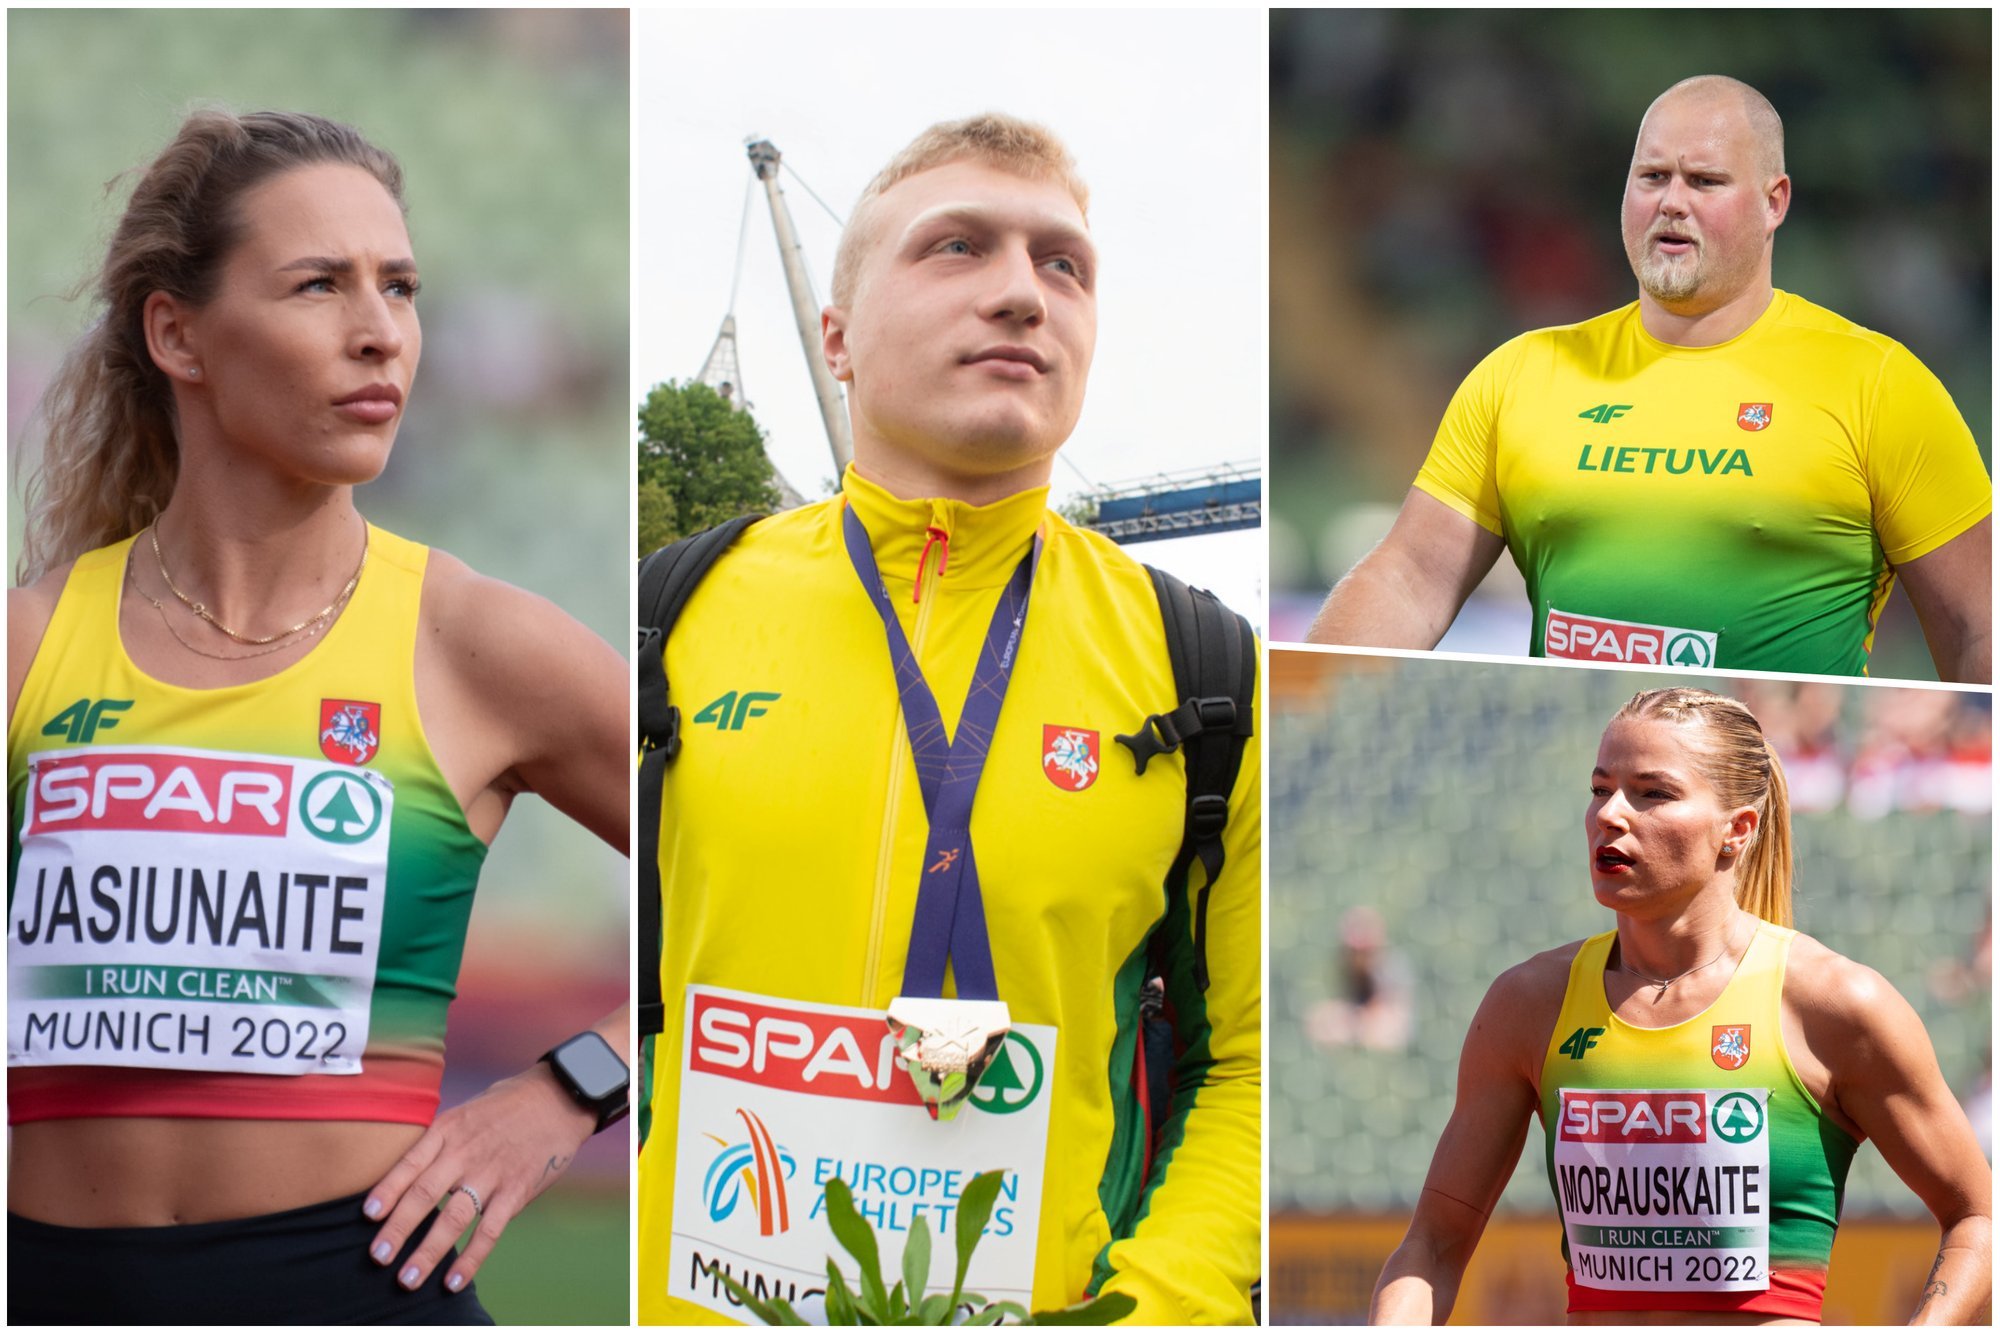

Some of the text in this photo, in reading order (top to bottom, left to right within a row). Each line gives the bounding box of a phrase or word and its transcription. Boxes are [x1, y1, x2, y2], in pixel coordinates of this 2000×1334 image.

[1578, 403, 1634, 424] 4F
[1577, 444, 1754, 477] LIETUVA
[1548, 619, 1659, 664] SPAR
[41, 698, 135, 743] 4F
[692, 690, 782, 731] 4F
[39, 764, 284, 826] SPAR
[17, 864, 369, 956] JASIUNAITE
[86, 969, 92, 994] I
[102, 969, 167, 996] RUN
[24, 1010, 347, 1061] MUNICH 2022
[1558, 1027, 1606, 1060] 4F
[1564, 1099, 1702, 1137] SPAR
[813, 1156, 1020, 1203] EUROPEN
[1559, 1163, 1761, 1216] MORAUSKAITE
[1599, 1229, 1604, 1245] I
[1609, 1229, 1646, 1246] RUN
[1578, 1251, 1757, 1282] MUNICH 2022
